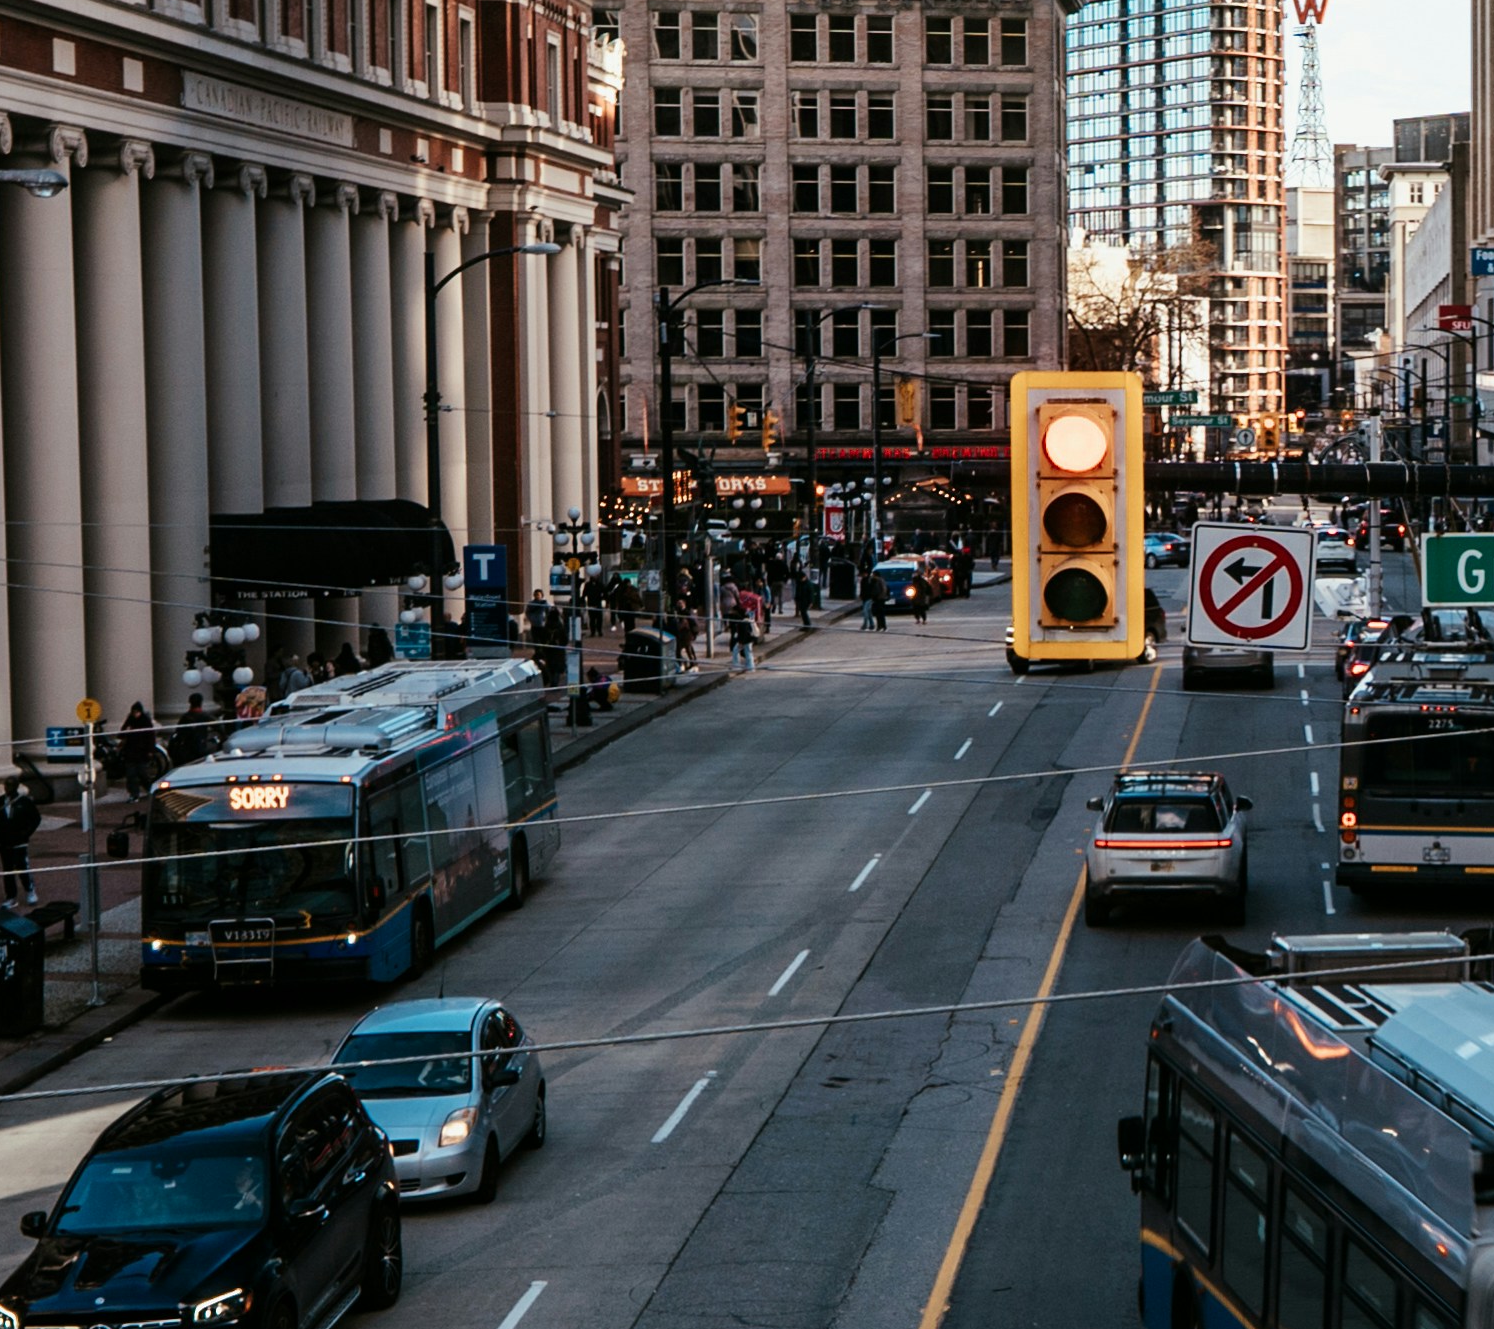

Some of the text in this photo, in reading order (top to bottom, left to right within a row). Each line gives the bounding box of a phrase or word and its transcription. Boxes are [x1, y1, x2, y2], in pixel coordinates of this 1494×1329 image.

[196, 80, 344, 140] CANADIAN PACIFIC RAILWAY
[1452, 320, 1471, 330] SFU
[1179, 392, 1193, 402] St
[1171, 416, 1229, 426] Seymour St
[472, 553, 496, 581] T
[237, 589, 309, 600] THE STATION
[229, 786, 289, 810] SORRY
